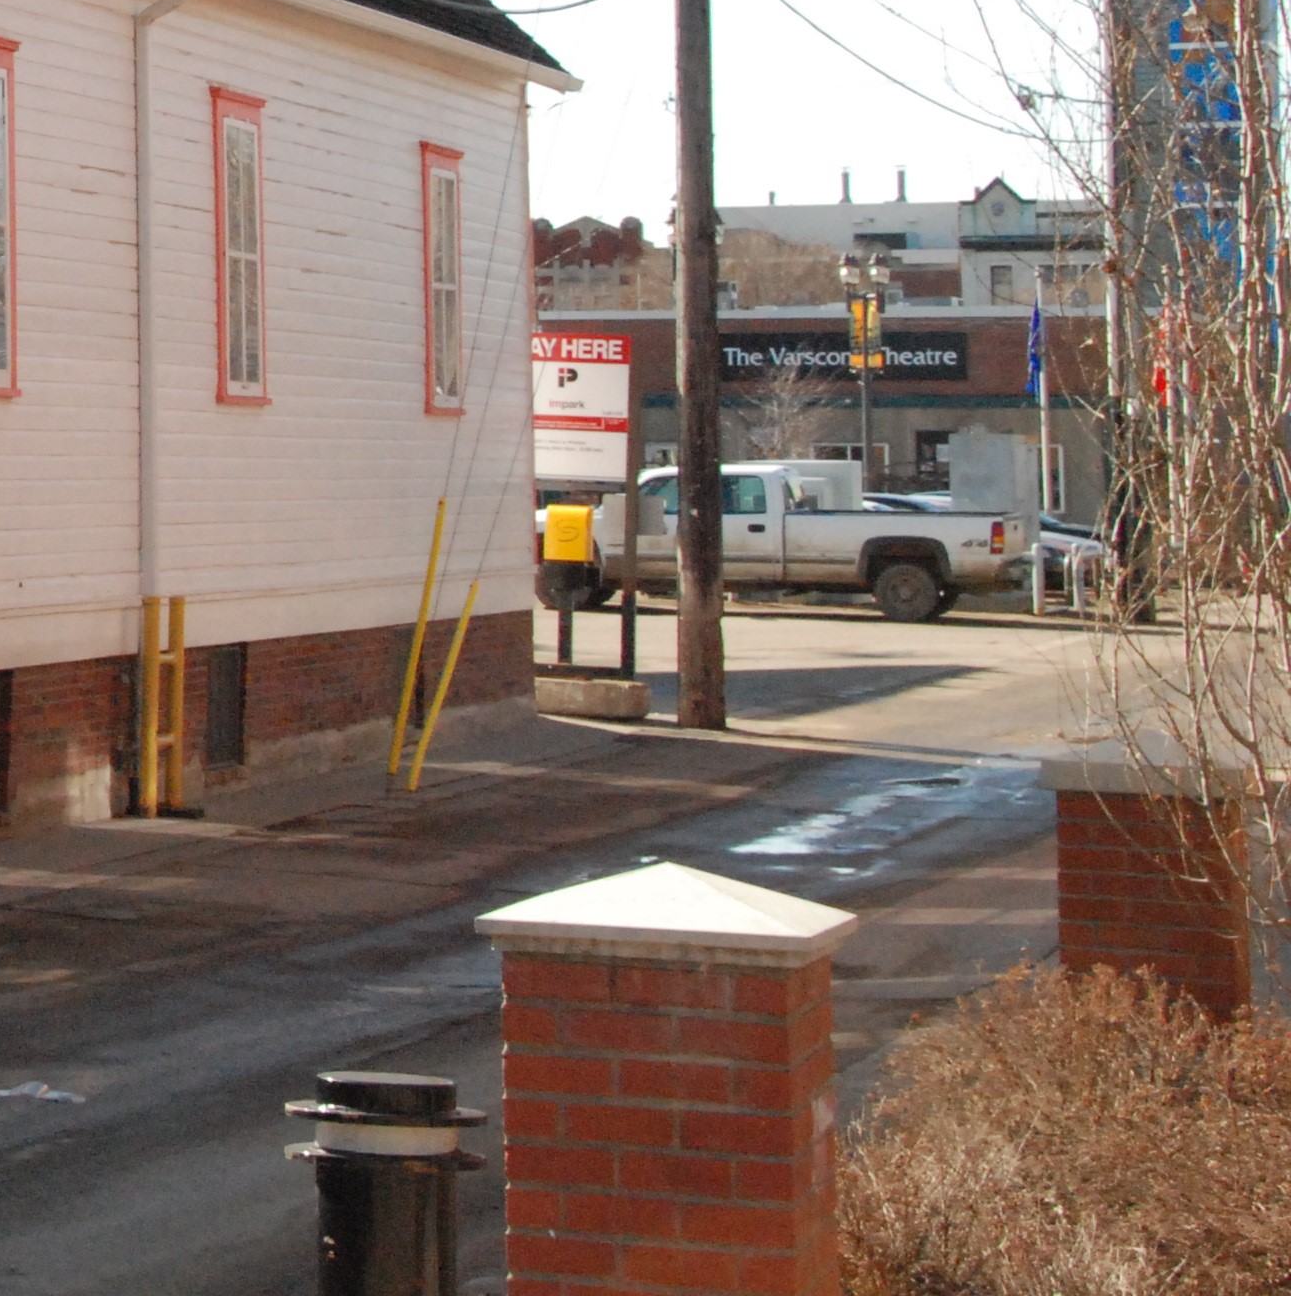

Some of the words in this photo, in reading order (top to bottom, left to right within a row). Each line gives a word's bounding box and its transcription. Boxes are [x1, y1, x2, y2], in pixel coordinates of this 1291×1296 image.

[531, 337, 557, 358] AY
[561, 338, 623, 360] HERE
[723, 347, 763, 366] The
[769, 347, 852, 366] Varscon
